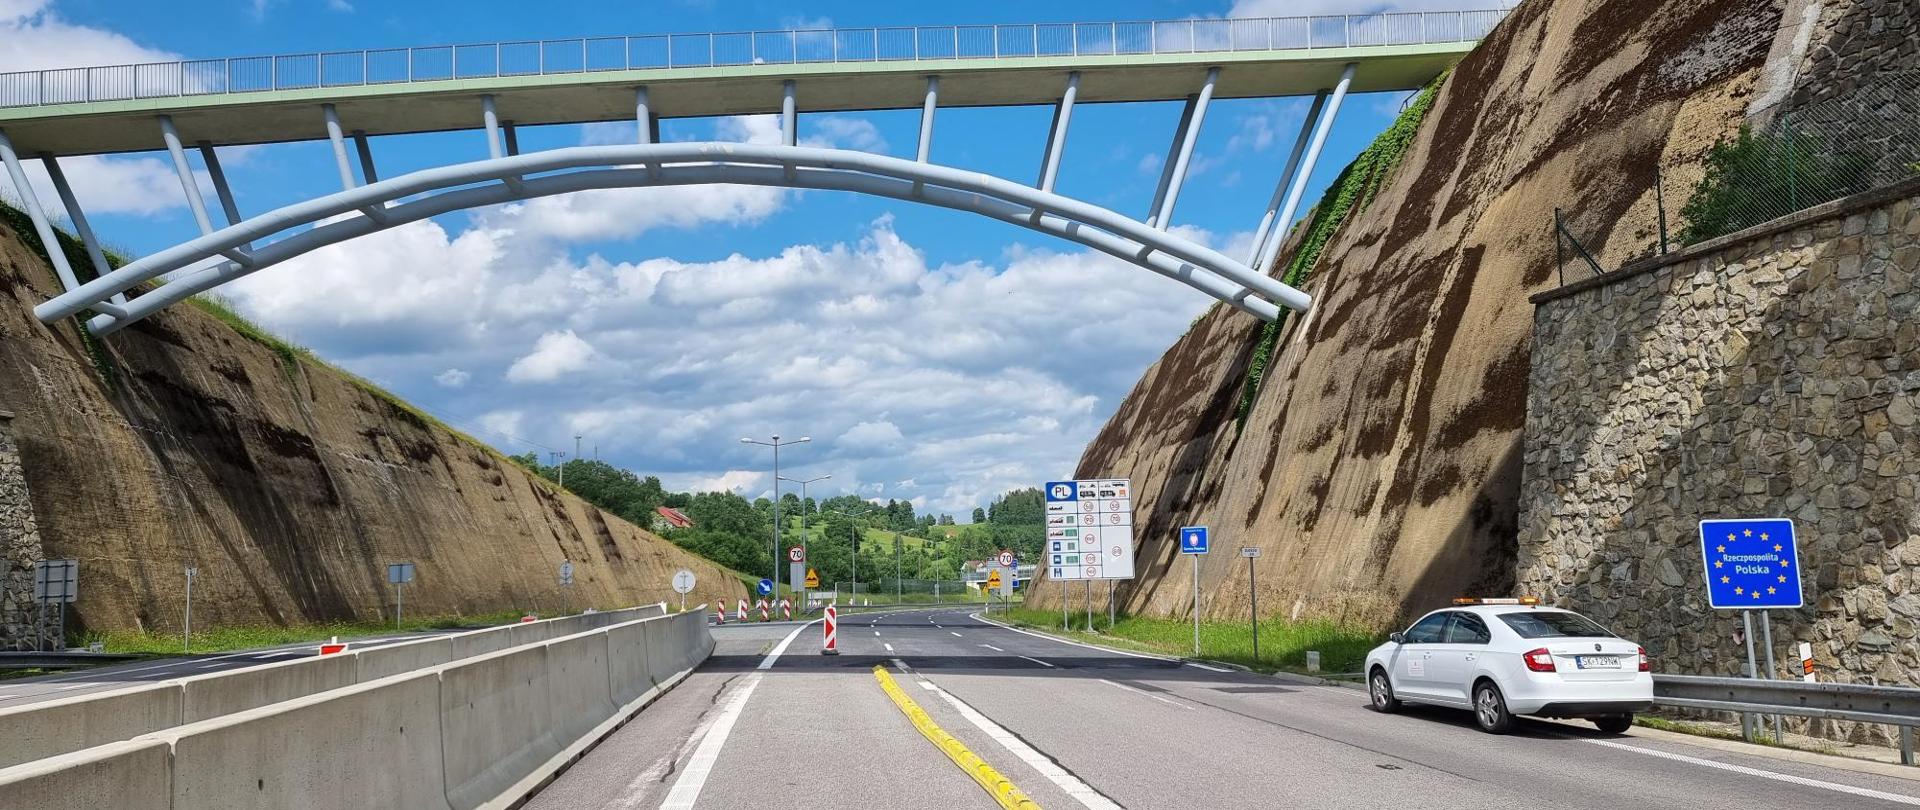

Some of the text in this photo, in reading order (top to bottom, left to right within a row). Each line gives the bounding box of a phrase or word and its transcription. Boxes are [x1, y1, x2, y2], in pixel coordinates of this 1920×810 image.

[1055, 487, 1068, 497] PL
[791, 550, 802, 559] 70
[1001, 555, 1012, 563] 70
[1722, 553, 1779, 563] Rzeczpospolita
[1735, 565, 1770, 575] Polska
